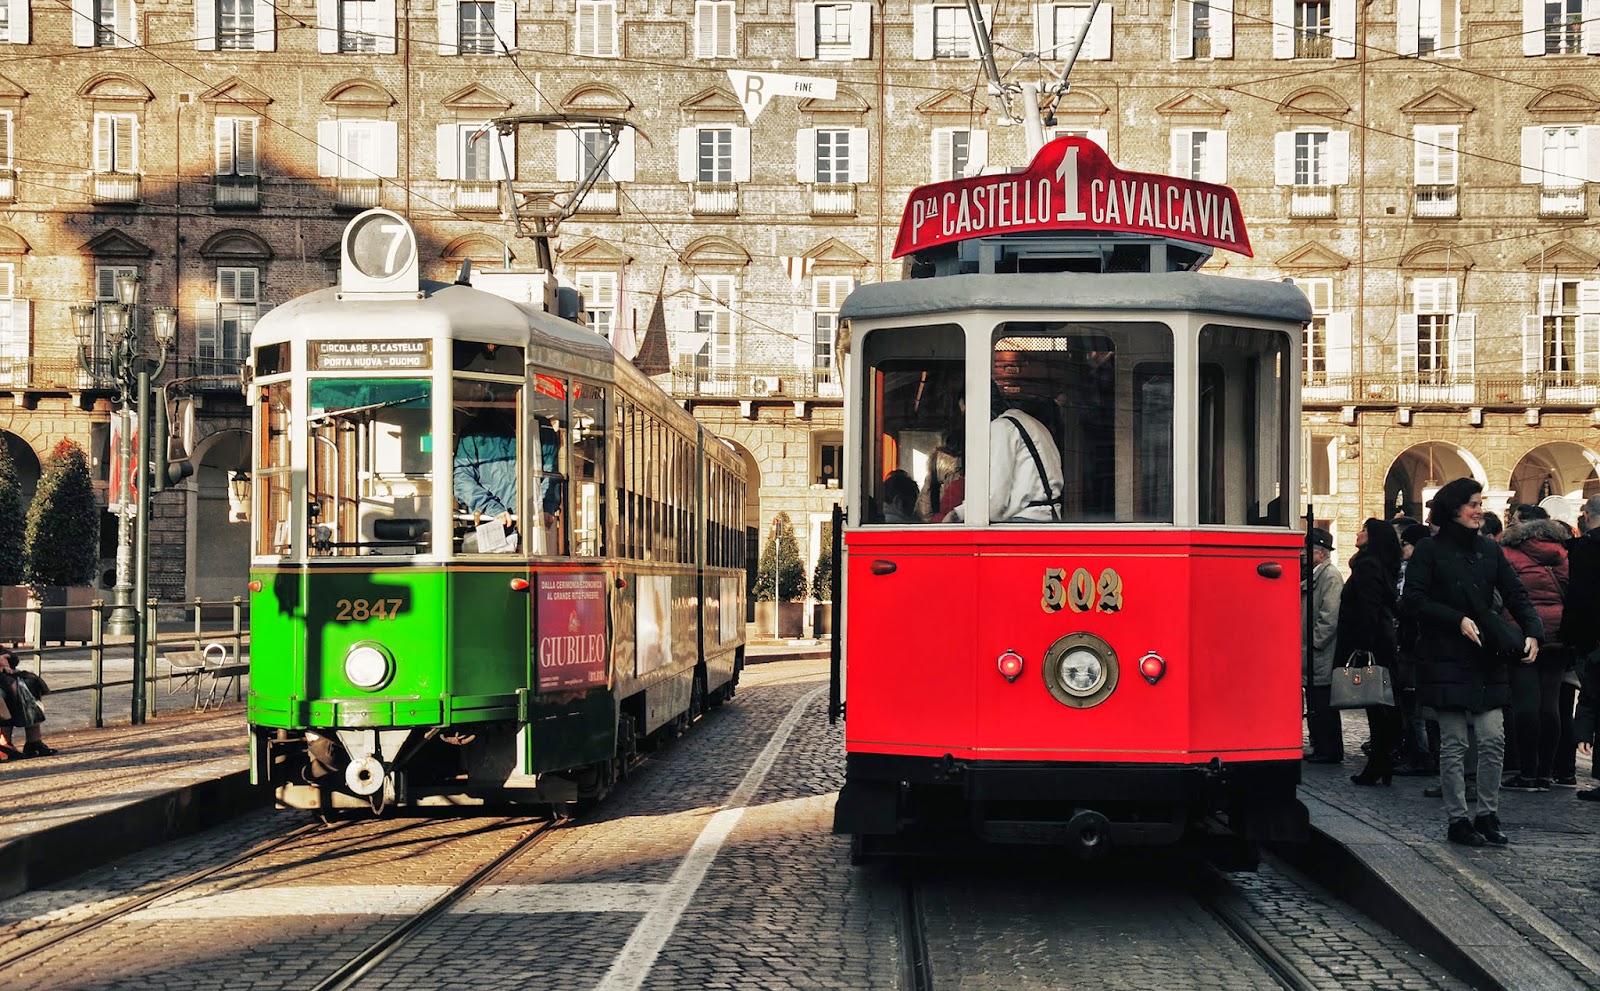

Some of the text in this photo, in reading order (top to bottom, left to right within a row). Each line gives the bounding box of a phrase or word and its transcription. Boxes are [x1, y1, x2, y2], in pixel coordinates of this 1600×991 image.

[744, 75, 813, 105] R FINE
[942, 178, 1051, 236] CASTELLO
[1056, 146, 1087, 221] 1
[1091, 179, 1236, 243] CAVALCAVIA
[381, 224, 407, 273] 7
[321, 343, 368, 352] CIRCOLARE
[324, 357, 352, 366] PORTA
[354, 357, 382, 366] NUOVA
[389, 357, 420, 366] DUOMO
[541, 581, 556, 589] DALLA
[547, 592, 553, 600] AL
[553, 591, 571, 600] GRANDE
[1041, 567, 1123, 614] 502
[336, 599, 403, 621] 2847
[540, 634, 605, 668] GIUBILEO
